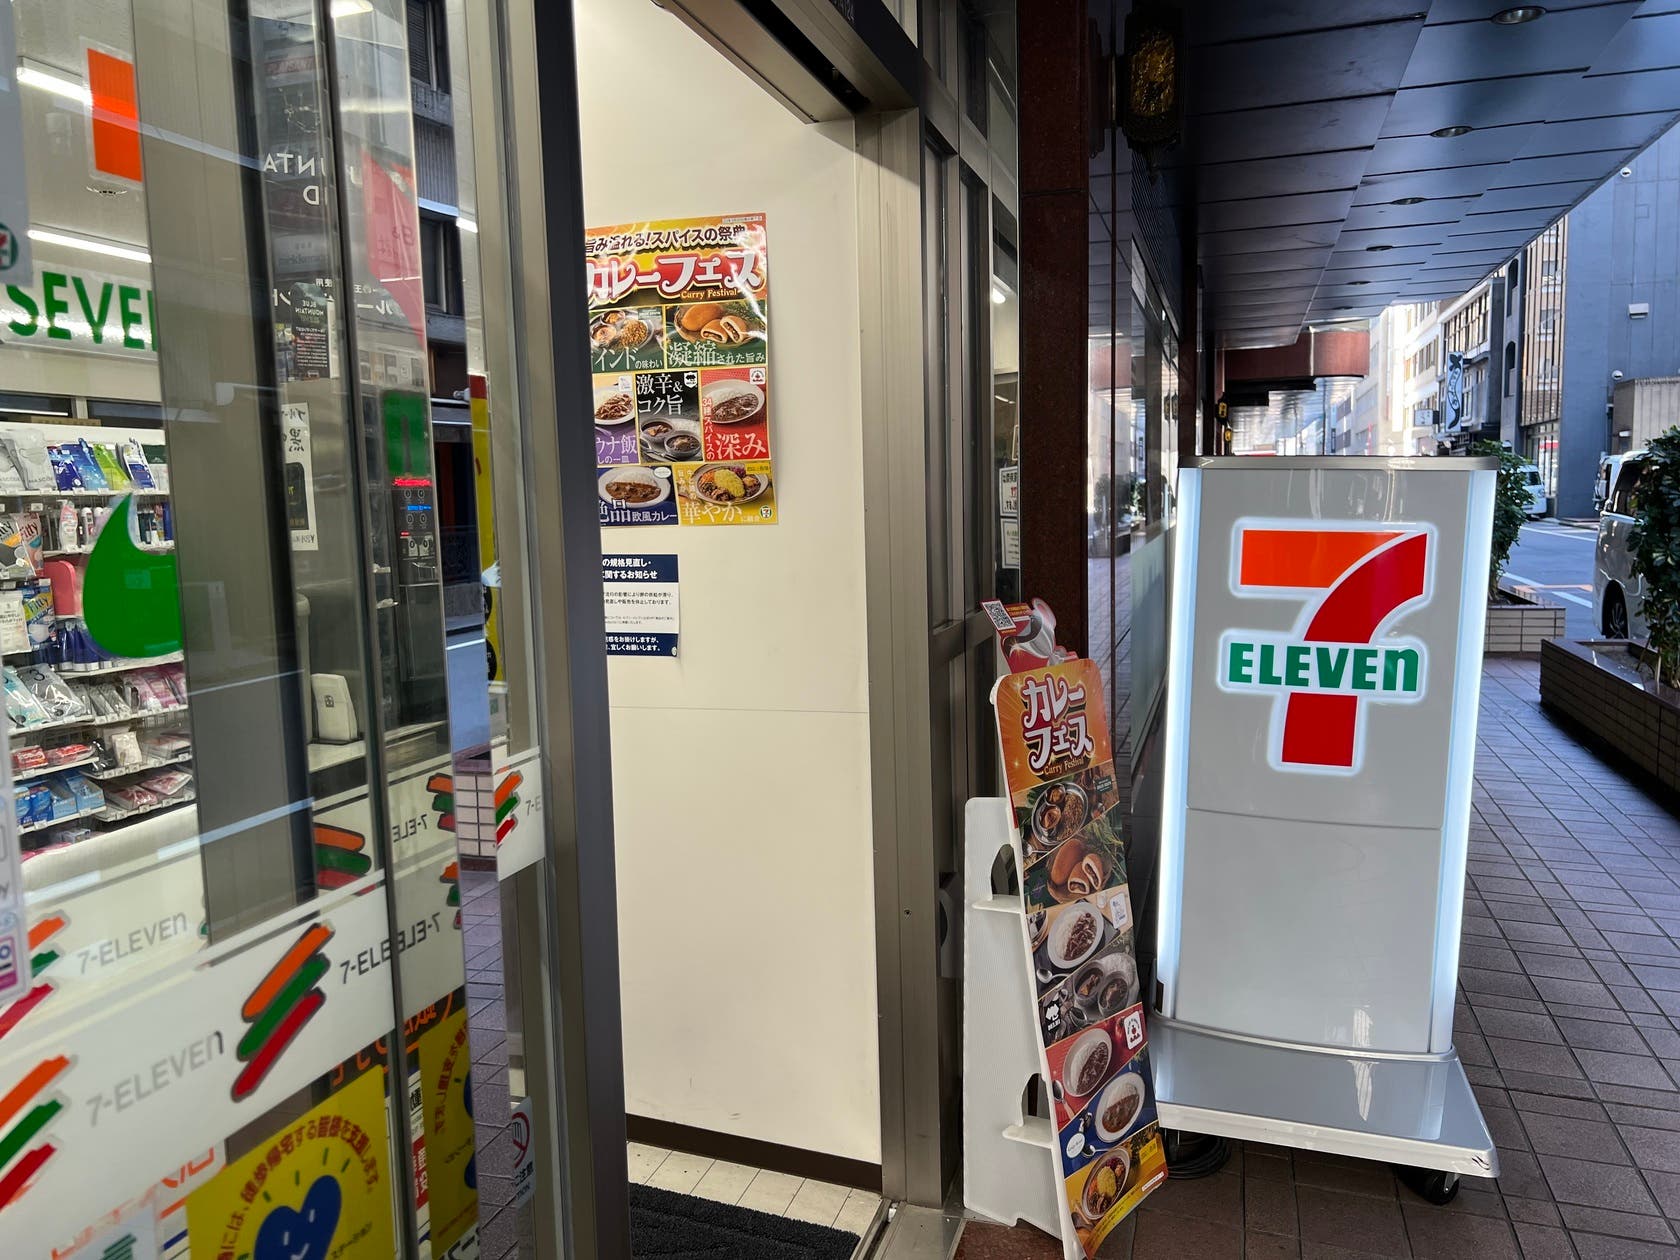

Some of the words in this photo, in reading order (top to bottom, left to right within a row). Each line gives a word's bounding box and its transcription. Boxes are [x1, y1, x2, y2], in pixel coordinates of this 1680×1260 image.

[587, 249, 762, 300] カレーフェス
[680, 289, 704, 300] Curry
[707, 287, 737, 298] Festival
[594, 346, 663, 371] インドの味わい
[636, 374, 684, 395] 激辛&
[638, 395, 684, 416] コク旨
[715, 432, 767, 459] 深み
[1240, 529, 1428, 767] 7
[1023, 676, 1085, 729] カレー
[1024, 715, 1094, 769] フェス
[1043, 763, 1063, 775] Curry
[1064, 757, 1086, 770] Festival
